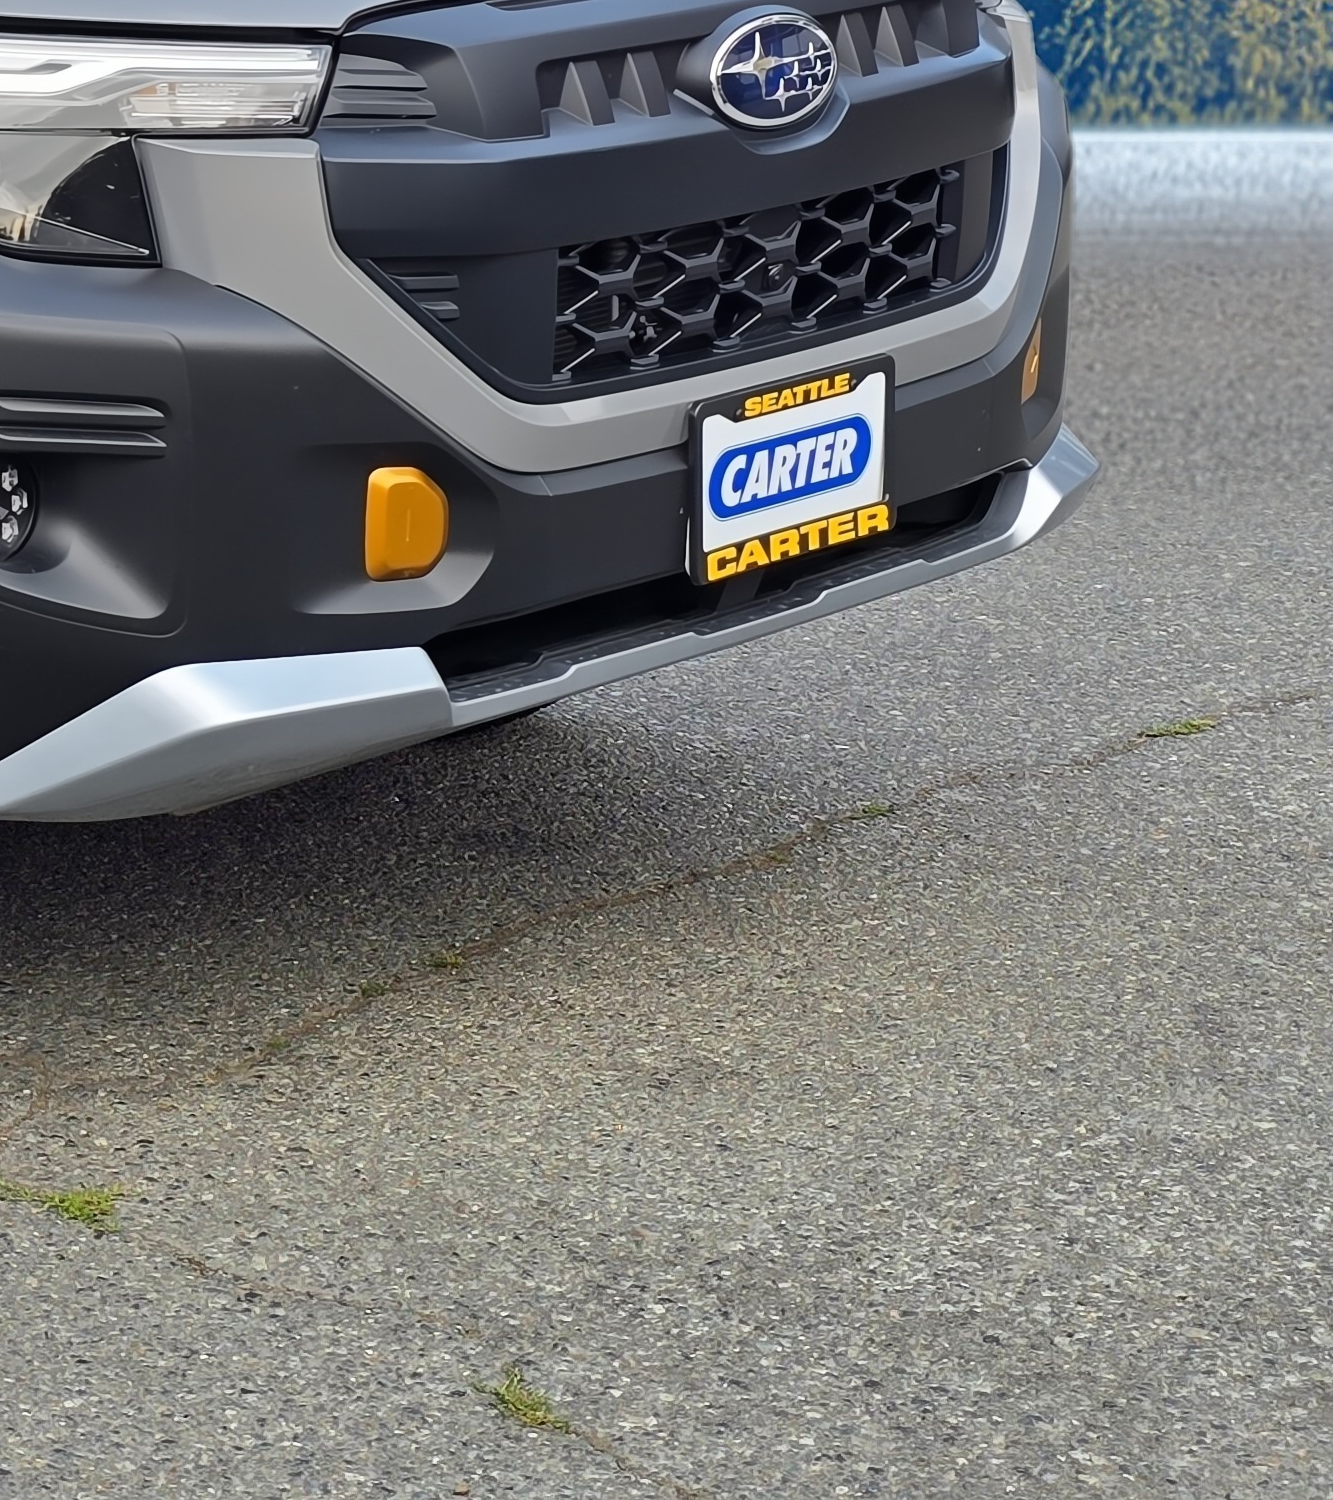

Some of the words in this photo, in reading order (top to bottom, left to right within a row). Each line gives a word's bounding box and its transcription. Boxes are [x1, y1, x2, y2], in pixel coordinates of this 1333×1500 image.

[744, 373, 851, 418] SEATTLE
[720, 427, 858, 508] CARTER
[706, 504, 890, 582] CARTER
